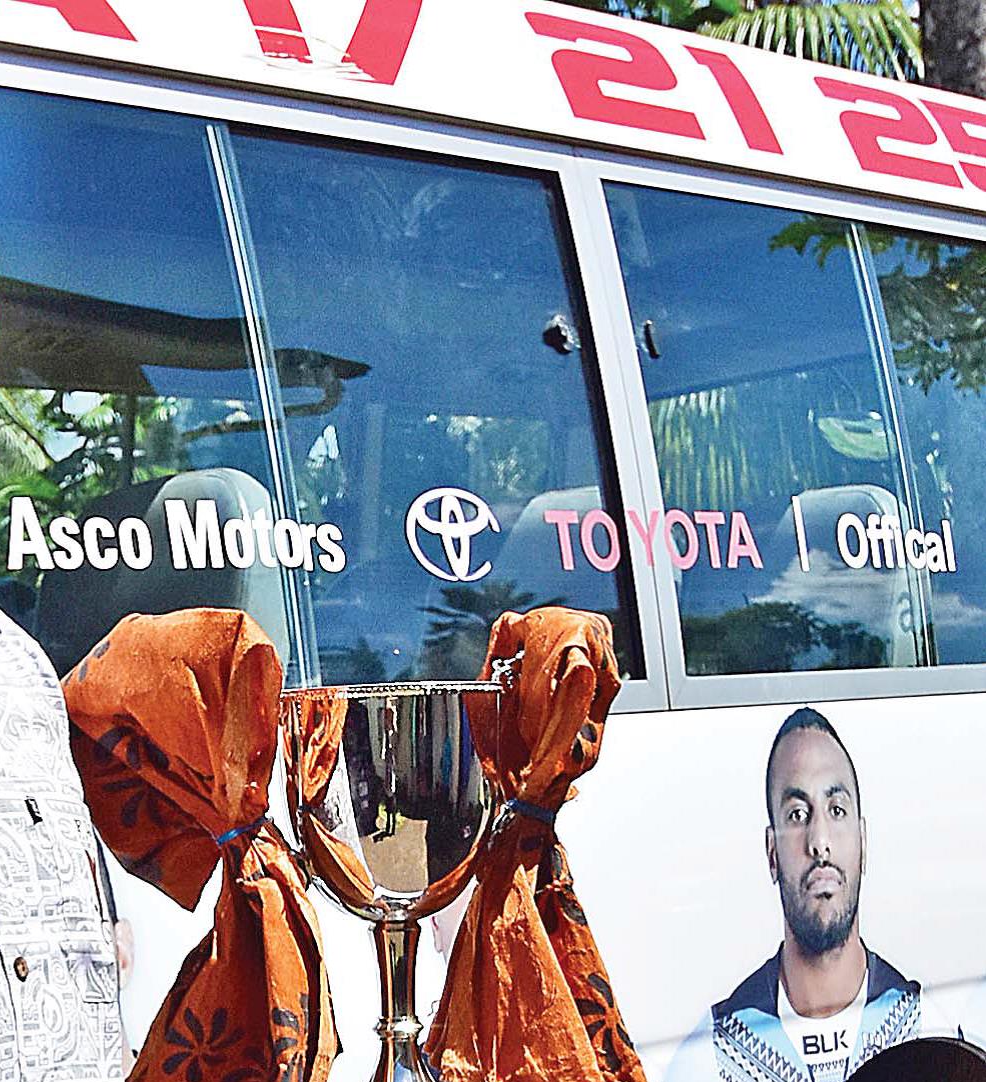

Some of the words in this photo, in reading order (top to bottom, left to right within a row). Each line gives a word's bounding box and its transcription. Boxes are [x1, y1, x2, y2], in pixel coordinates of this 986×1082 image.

[524, 12, 784, 155] 21
[7, 496, 153, 570] Asco
[164, 498, 347, 573] Motors
[543, 509, 764, 571] TOYOTA
[837, 512, 957, 573] Offical
[802, 1029, 849, 1055] BLK
